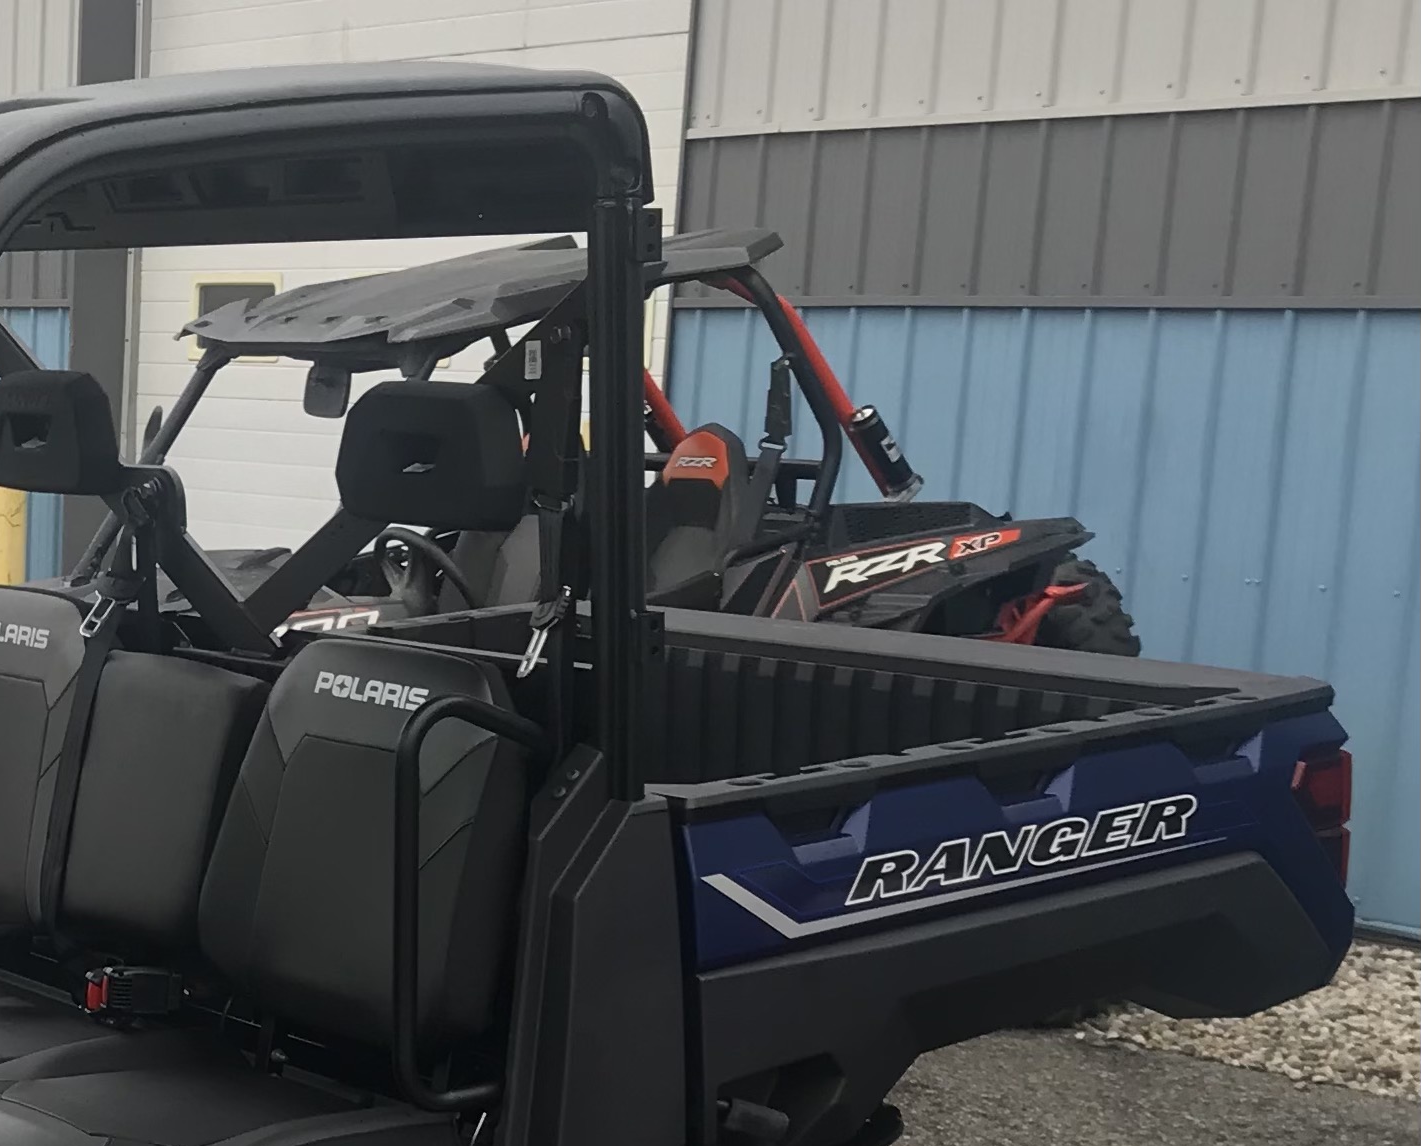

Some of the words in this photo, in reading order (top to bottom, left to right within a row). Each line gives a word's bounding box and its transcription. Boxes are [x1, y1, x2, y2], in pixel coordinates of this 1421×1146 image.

[675, 457, 717, 468] RZR
[823, 542, 946, 593] RZR
[956, 532, 1001, 557] XP
[314, 671, 429, 711] POLARIS
[845, 794, 1197, 905] RANGER
